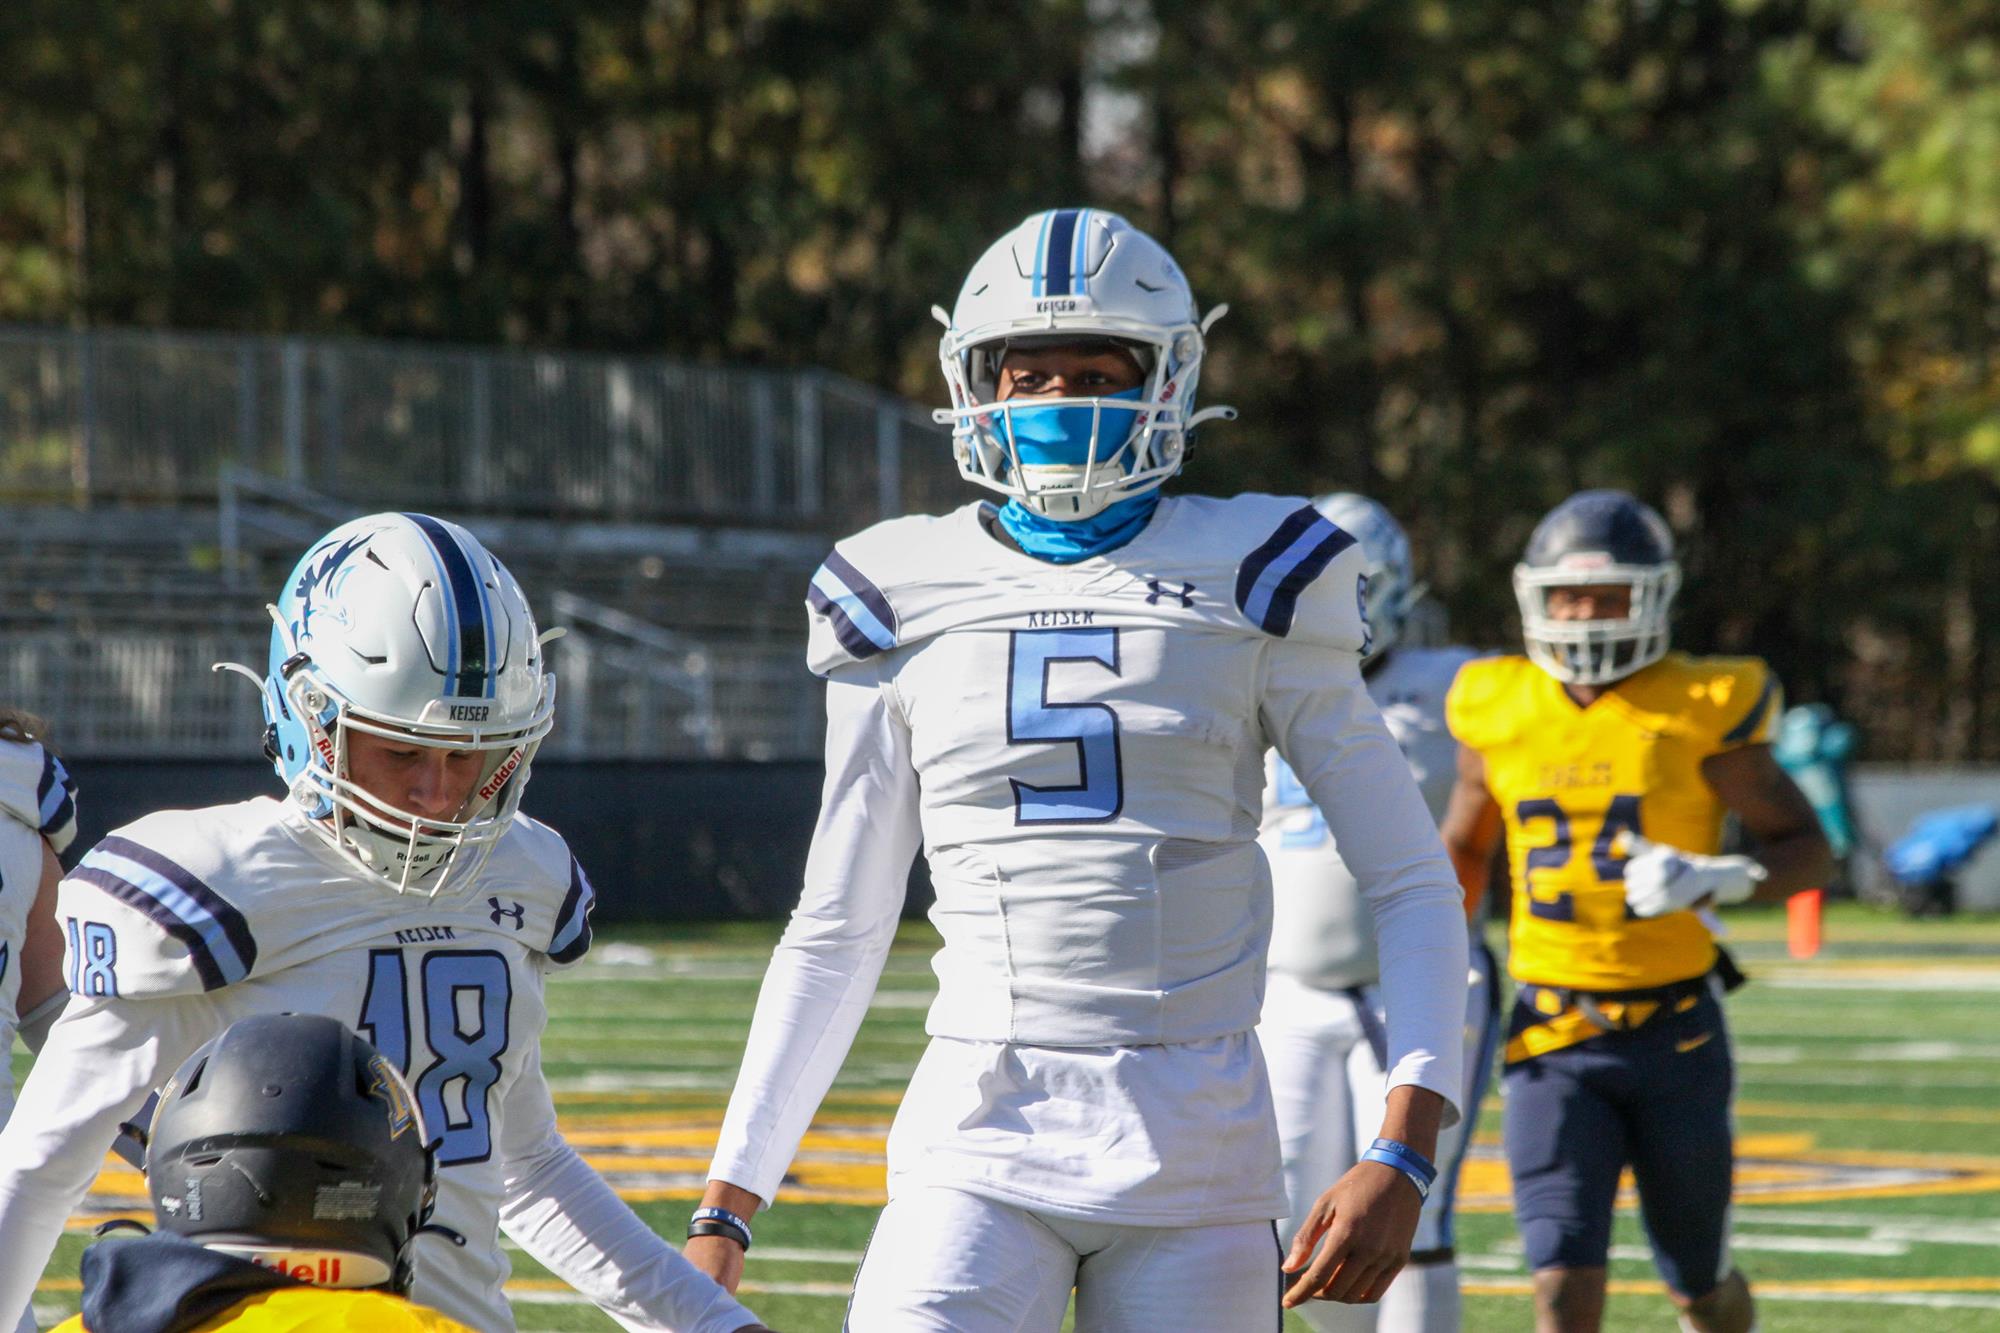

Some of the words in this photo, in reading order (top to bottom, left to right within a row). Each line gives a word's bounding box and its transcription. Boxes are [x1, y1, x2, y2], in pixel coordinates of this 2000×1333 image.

[450, 705, 489, 721] KEISER
[1006, 627, 1121, 826] 5
[479, 750, 523, 801] Riddell
[1517, 794, 1643, 922] 24
[66, 916, 120, 998] 18
[357, 948, 512, 1167] 18
